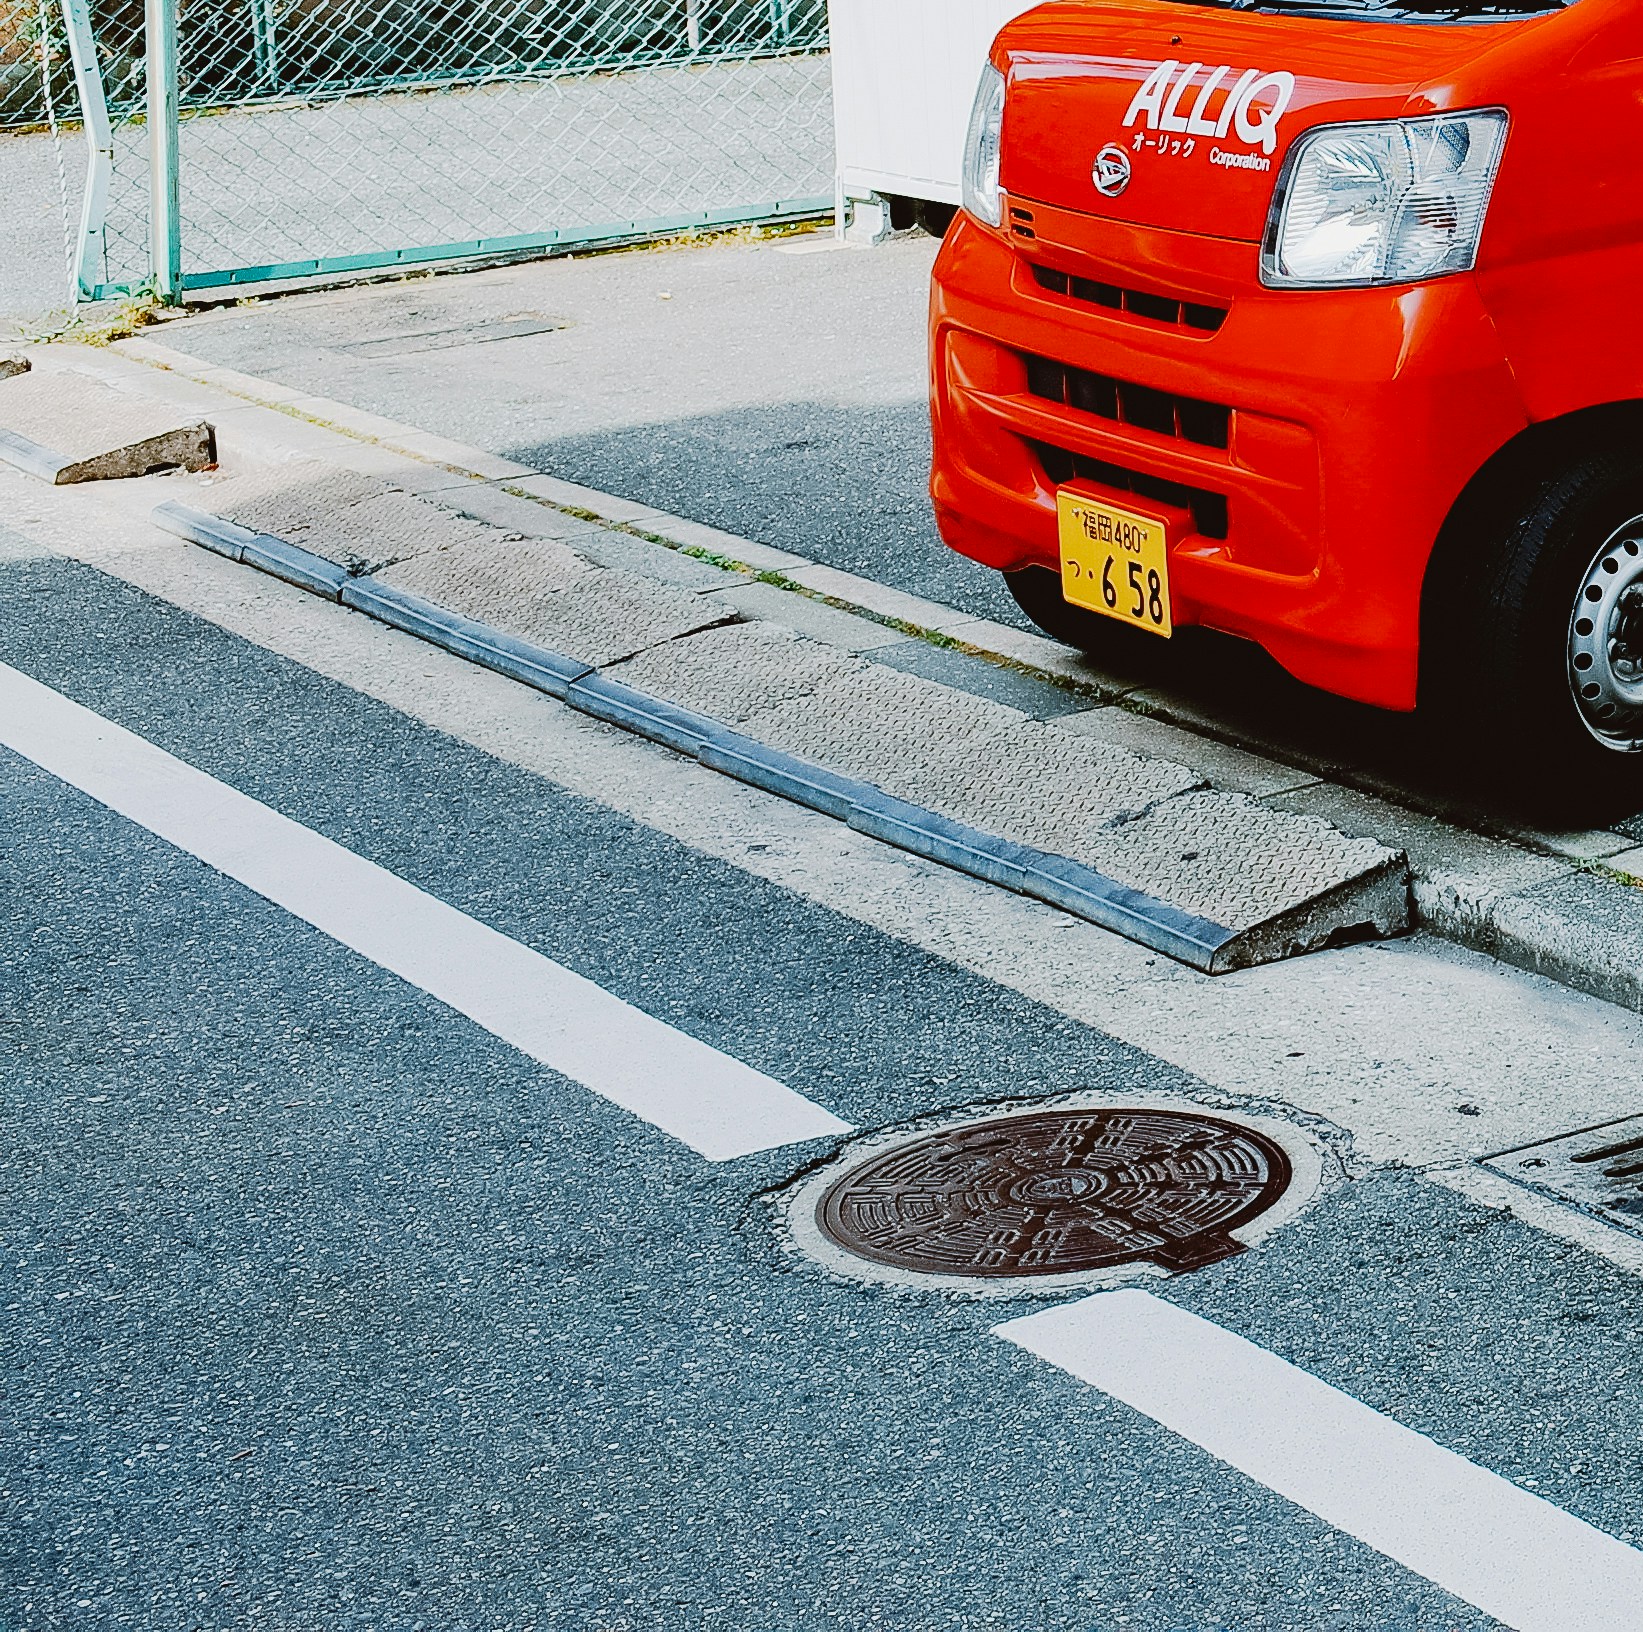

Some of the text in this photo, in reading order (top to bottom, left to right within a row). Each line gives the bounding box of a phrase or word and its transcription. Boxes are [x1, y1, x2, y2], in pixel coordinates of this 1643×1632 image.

[1123, 58, 1295, 157] ALLIQ
[1131, 131, 1271, 172] オーリック Corporation
